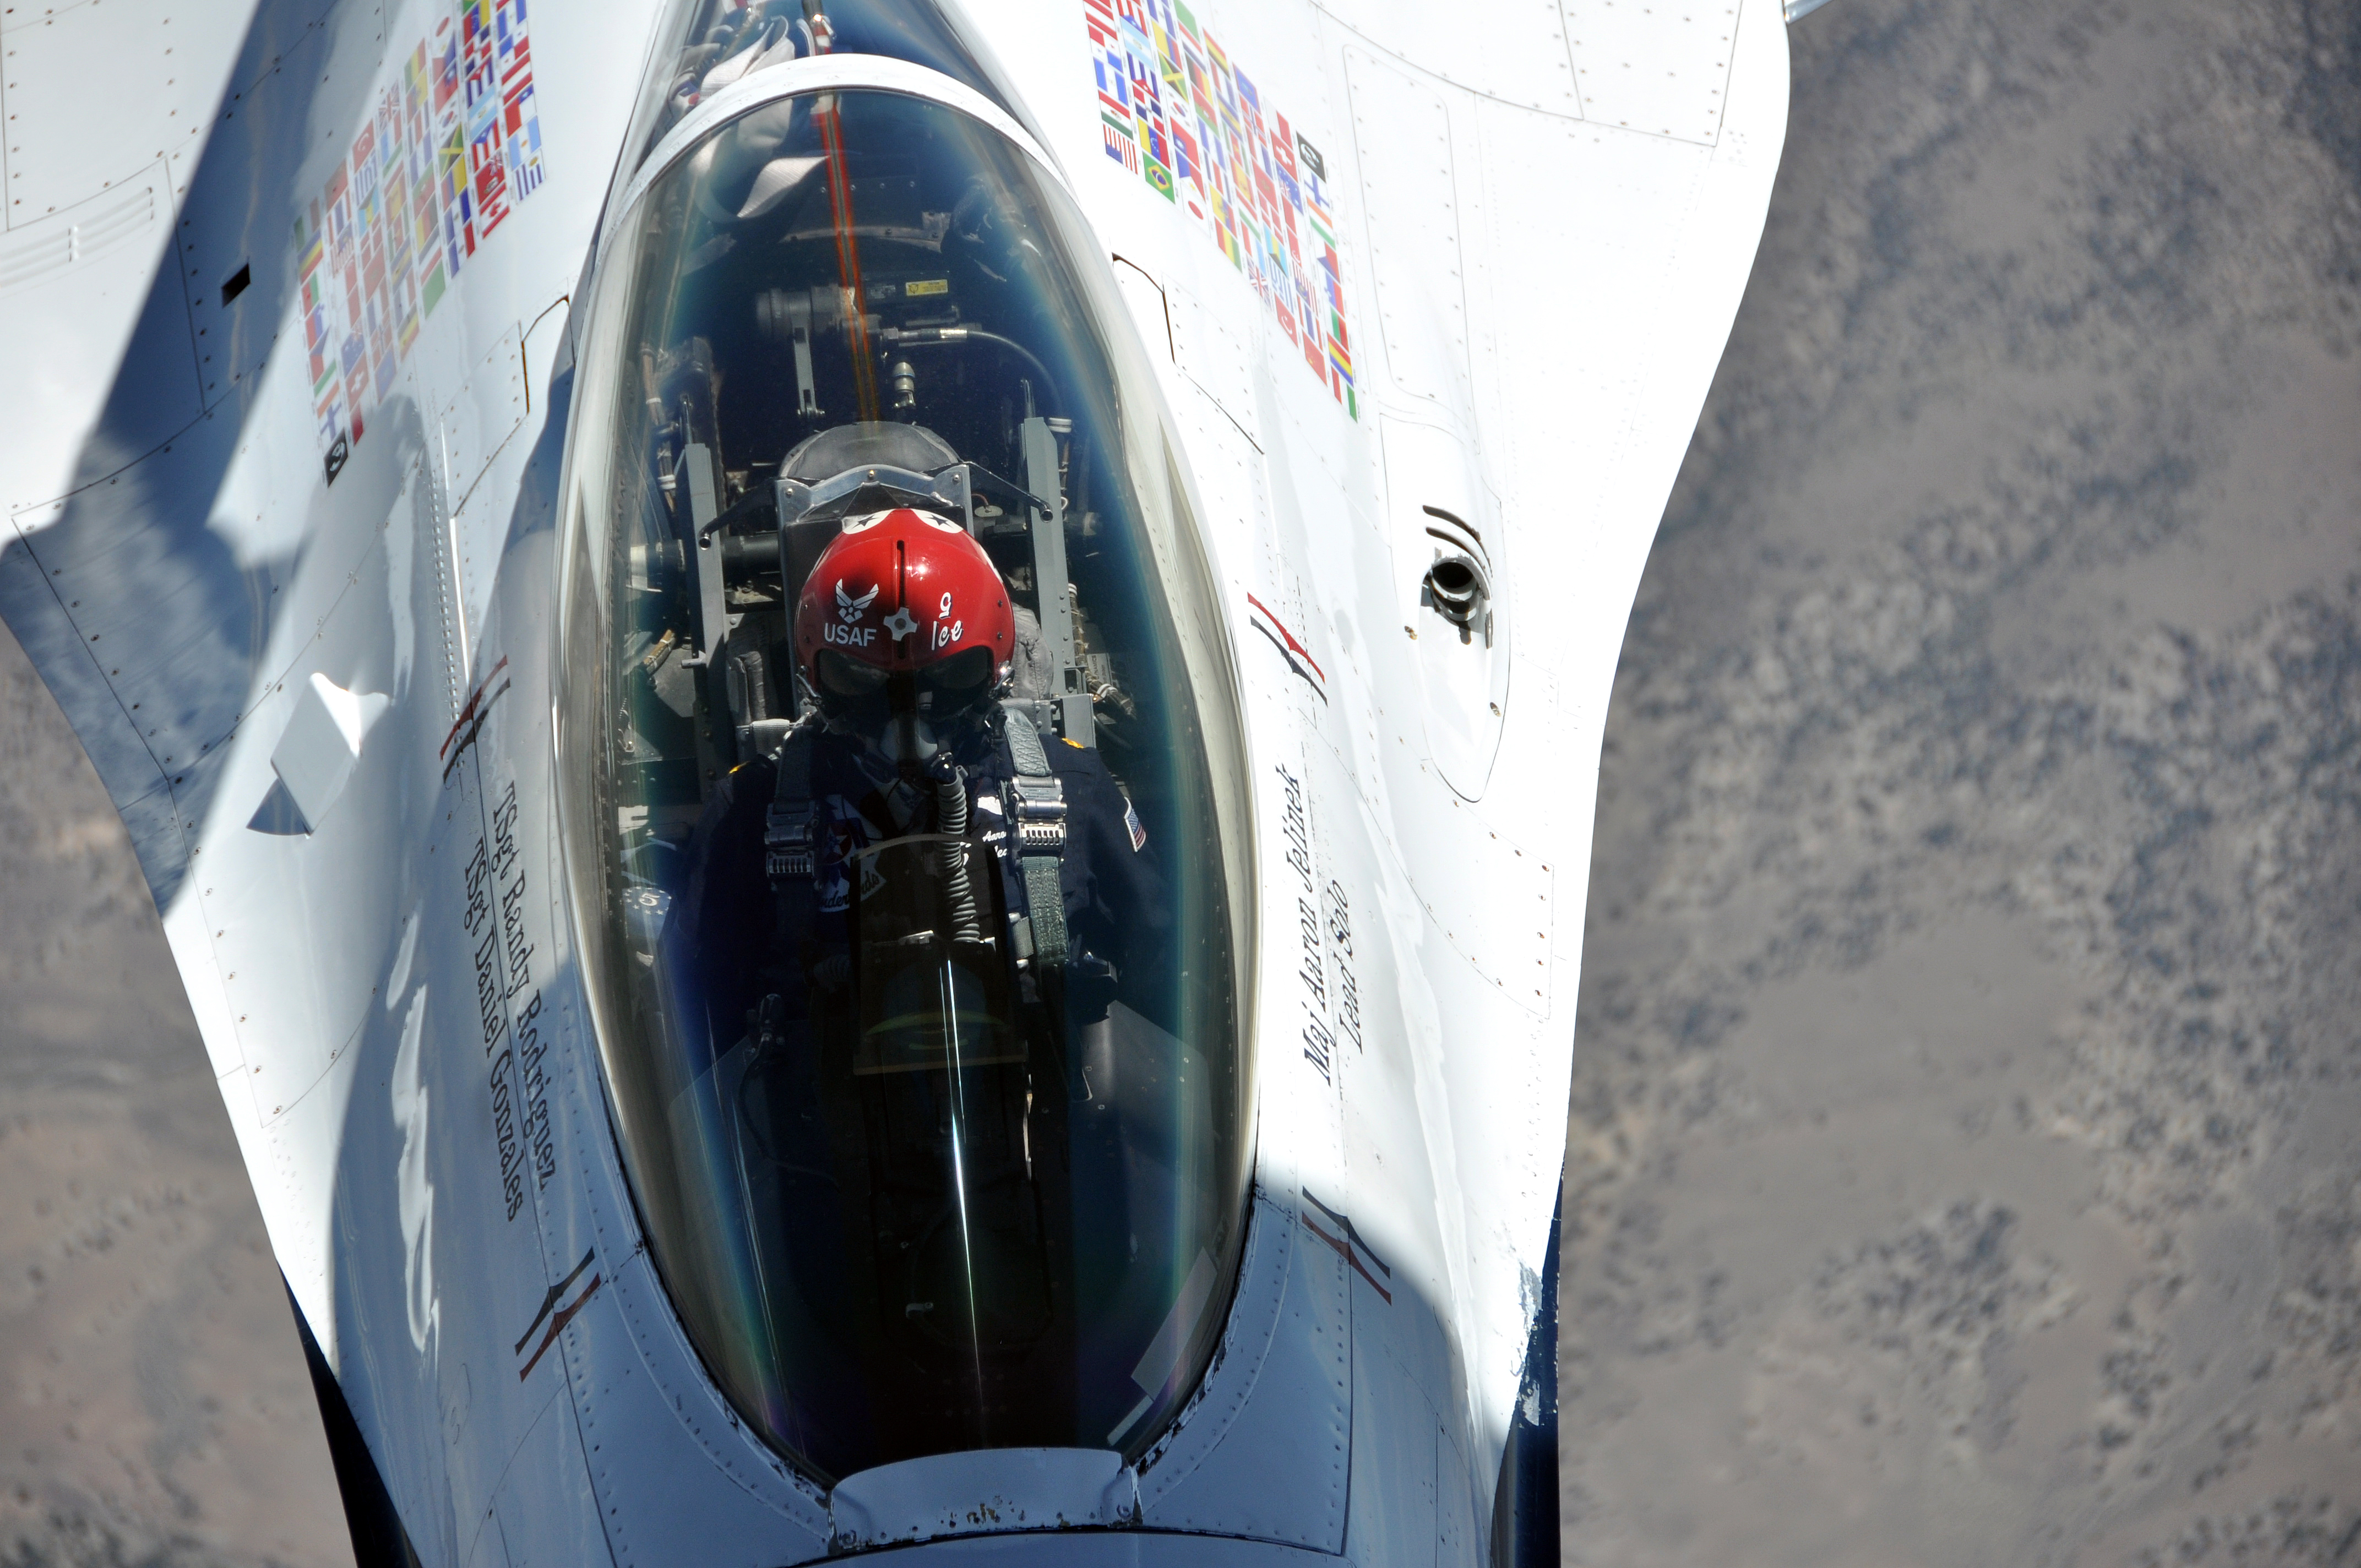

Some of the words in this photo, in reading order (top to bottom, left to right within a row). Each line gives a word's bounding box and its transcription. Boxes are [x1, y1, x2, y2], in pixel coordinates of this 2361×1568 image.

[824, 622, 877, 647] USAF
[931, 620, 964, 651] Ice
[491, 780, 520, 881] TSgt
[1275, 763, 1313, 893] Jelinek
[464, 835, 489, 938] TSgt
[503, 868, 534, 1000] Randy
[639, 892, 660, 906] 5
[1326, 879, 1354, 962] Solo
[475, 924, 507, 1059] Daniel
[1298, 897, 1326, 1013] Aaron
[1333, 950, 1363, 1055] Lead
[516, 988, 556, 1191] Rodriguez
[1302, 1000, 1337, 1088] Maj
[490, 1049, 524, 1222] Gonzales
